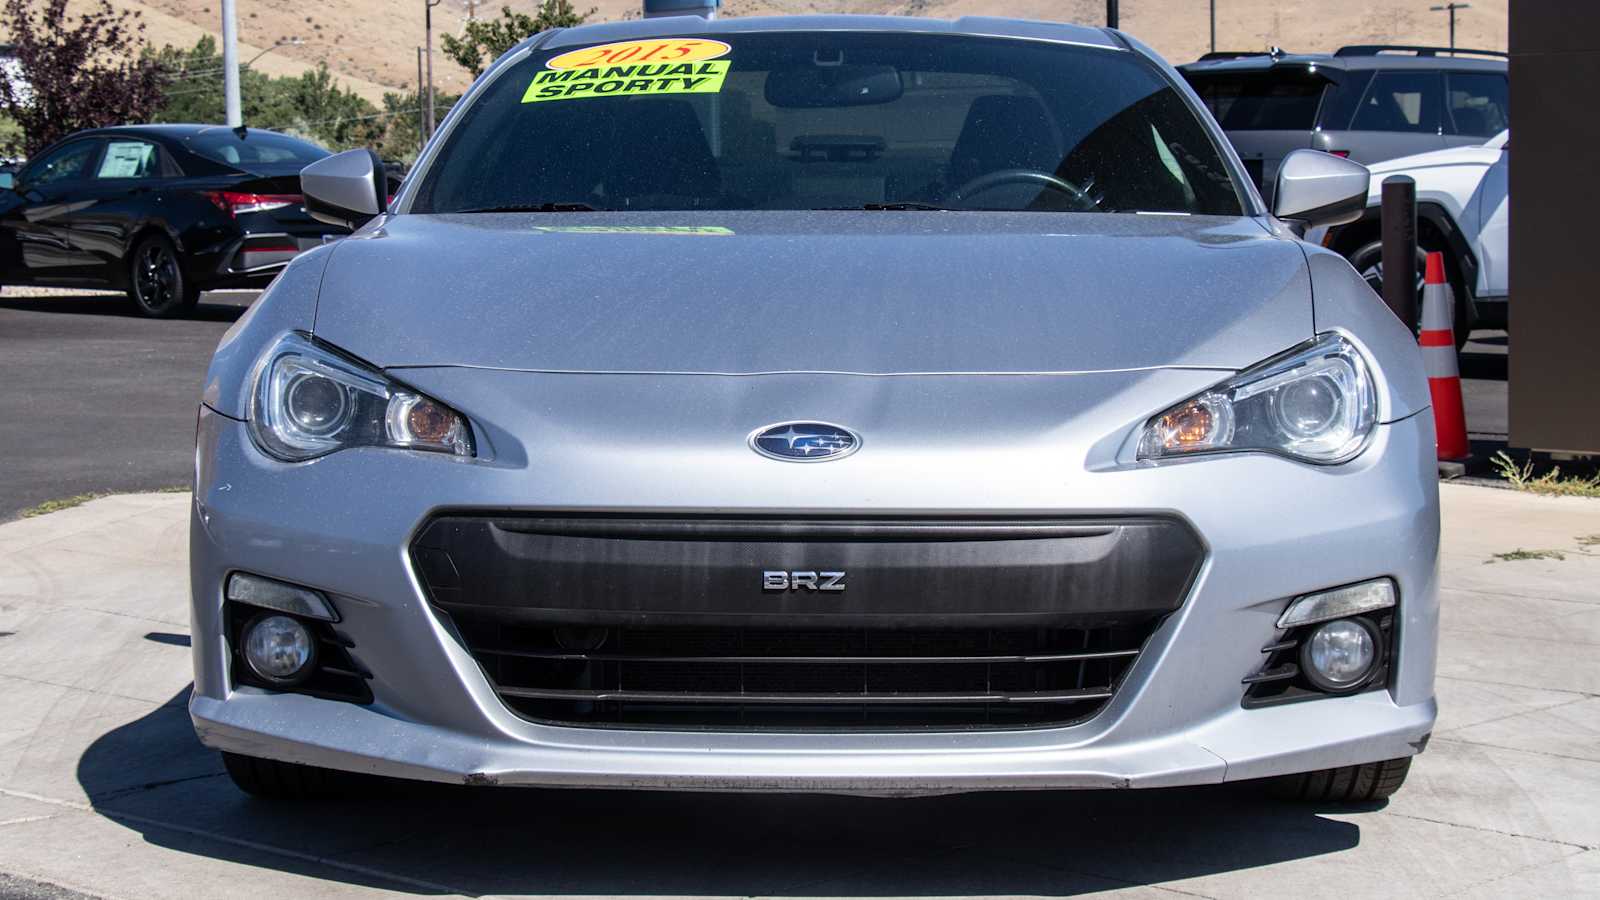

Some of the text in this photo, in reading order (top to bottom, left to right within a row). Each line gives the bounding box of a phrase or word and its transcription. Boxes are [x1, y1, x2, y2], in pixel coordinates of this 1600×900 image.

[576, 42, 702, 67] 2015
[536, 62, 720, 84] MANUAL
[535, 77, 708, 98] SPORTY
[763, 570, 846, 591] BRZ
